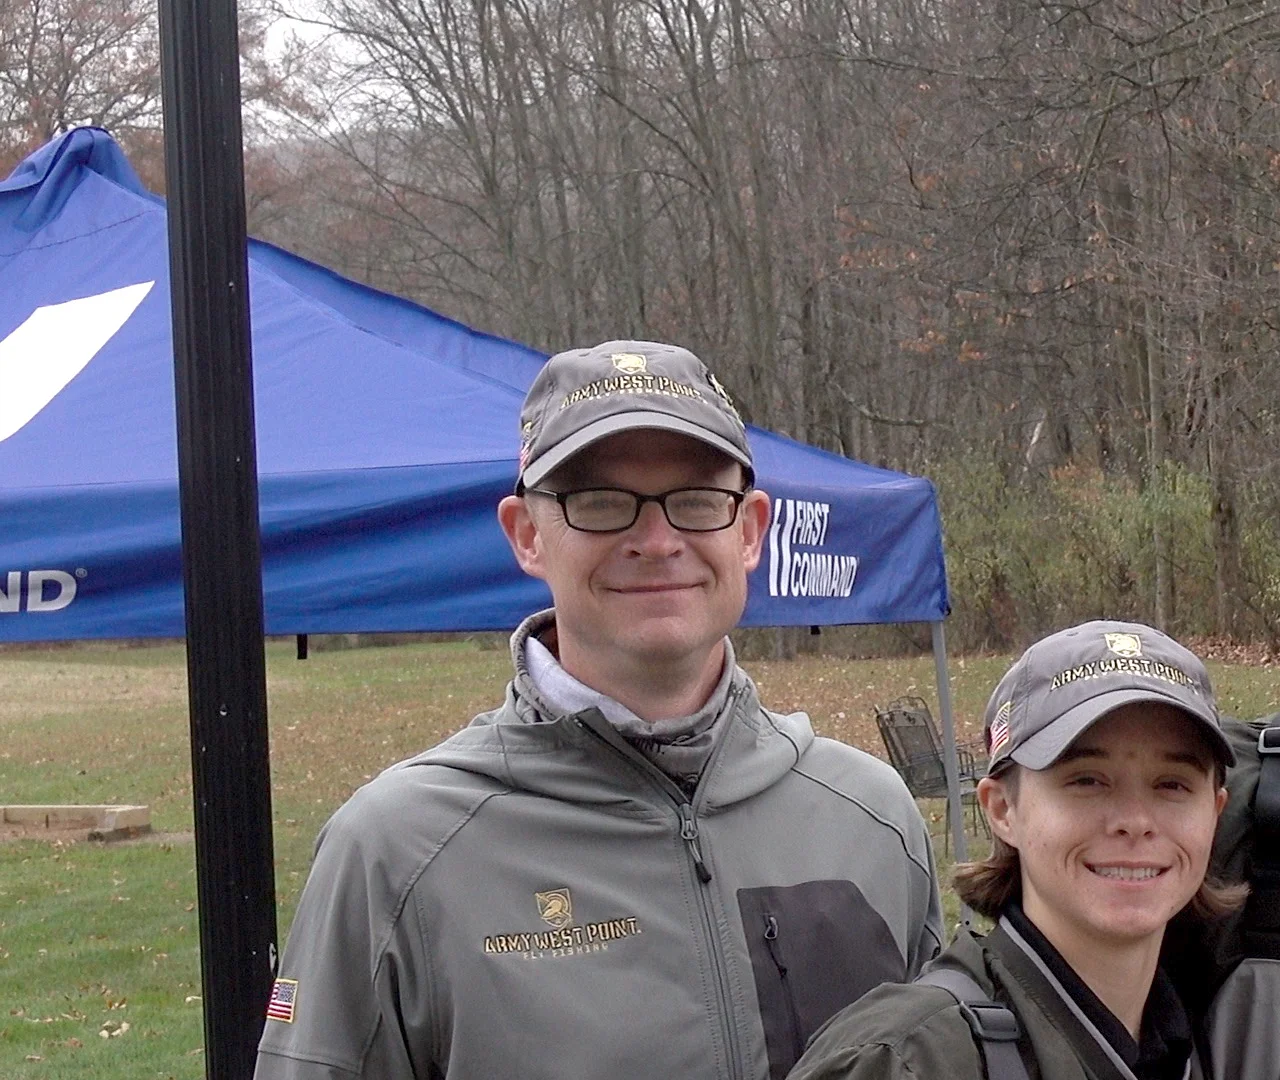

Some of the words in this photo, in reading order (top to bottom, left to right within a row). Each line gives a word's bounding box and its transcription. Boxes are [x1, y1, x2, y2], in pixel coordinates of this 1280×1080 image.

[561, 380, 601, 408] ARMY
[603, 375, 655, 392] WEST
[792, 500, 829, 546] FIRST
[791, 552, 858, 597] COMMAND
[1050, 661, 1097, 690] ARMY
[1099, 658, 1151, 673] WEST
[484, 933, 531, 954] ARMY
[534, 926, 583, 949] WEST
[523, 951, 544, 960] FLY
[552, 943, 609, 958] FISHING
